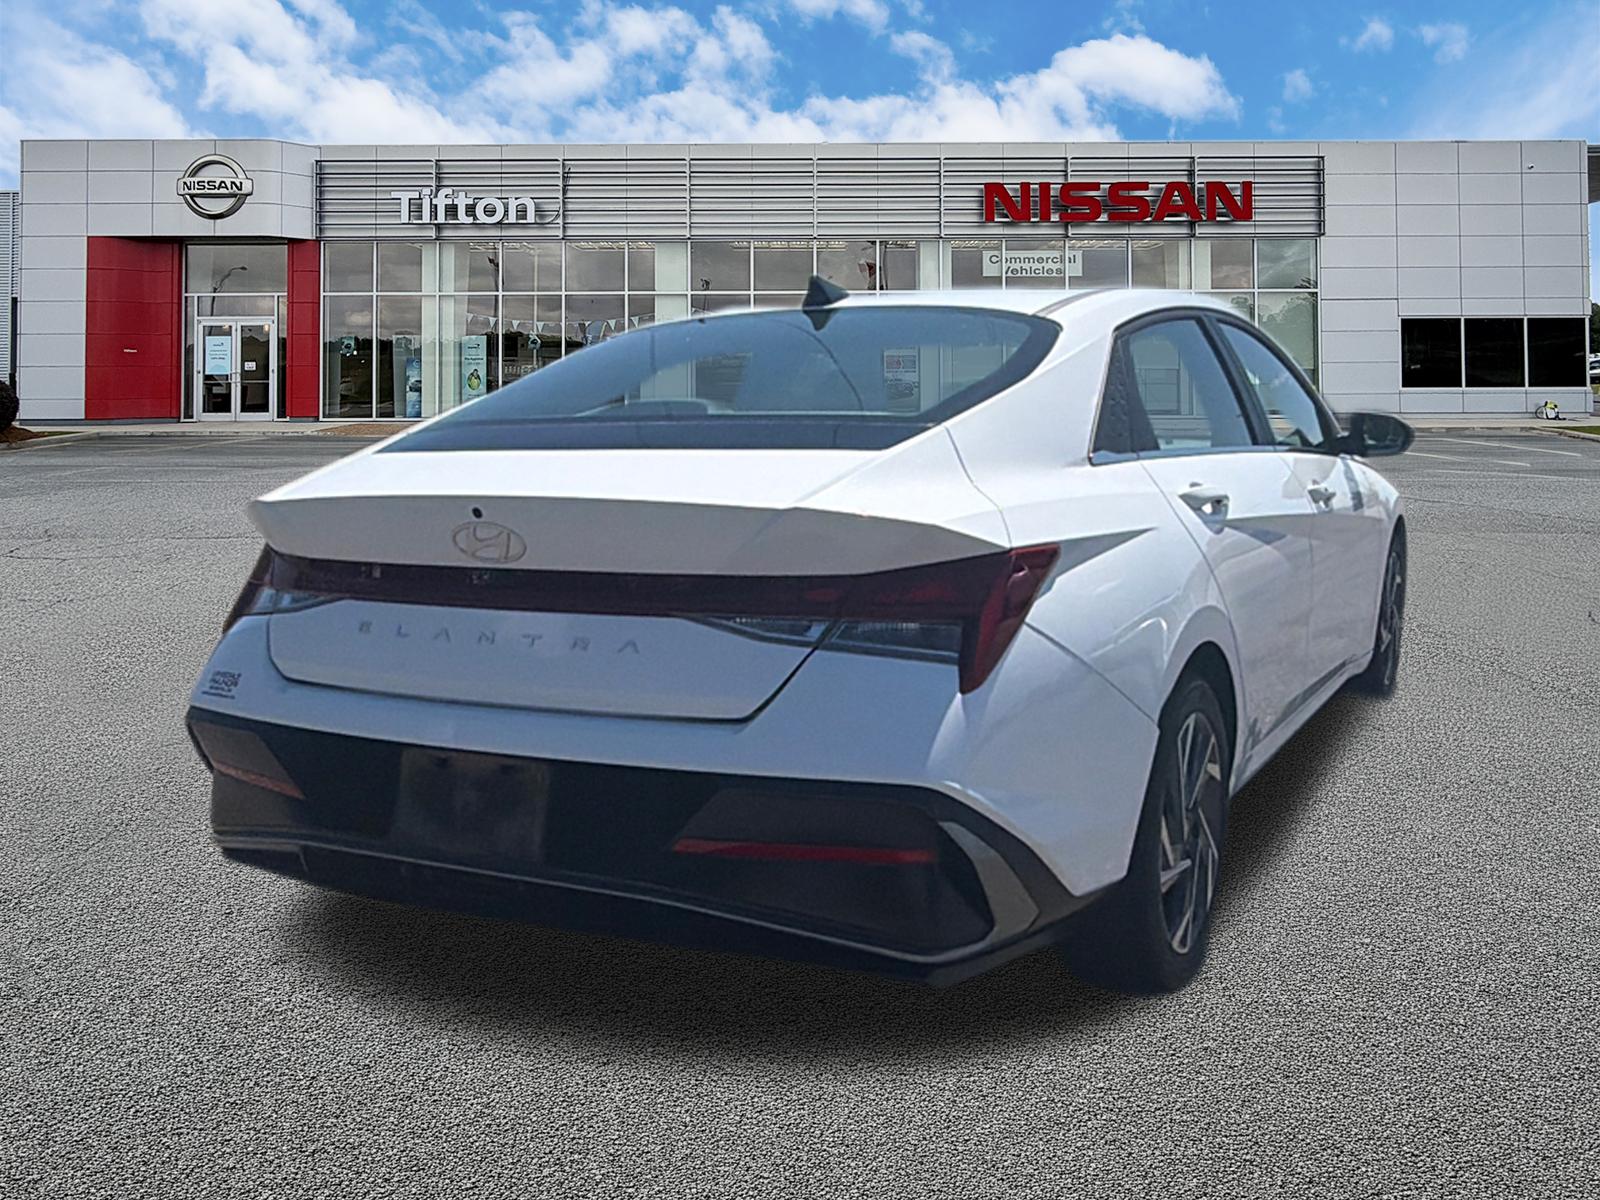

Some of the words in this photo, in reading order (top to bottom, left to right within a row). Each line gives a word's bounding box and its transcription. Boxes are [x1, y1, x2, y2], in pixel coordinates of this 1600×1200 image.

[183, 180, 243, 191] NISSAN
[984, 181, 1253, 222] NISSAN
[391, 188, 536, 224] Tifton
[358, 621, 640, 655] ELANTRA
